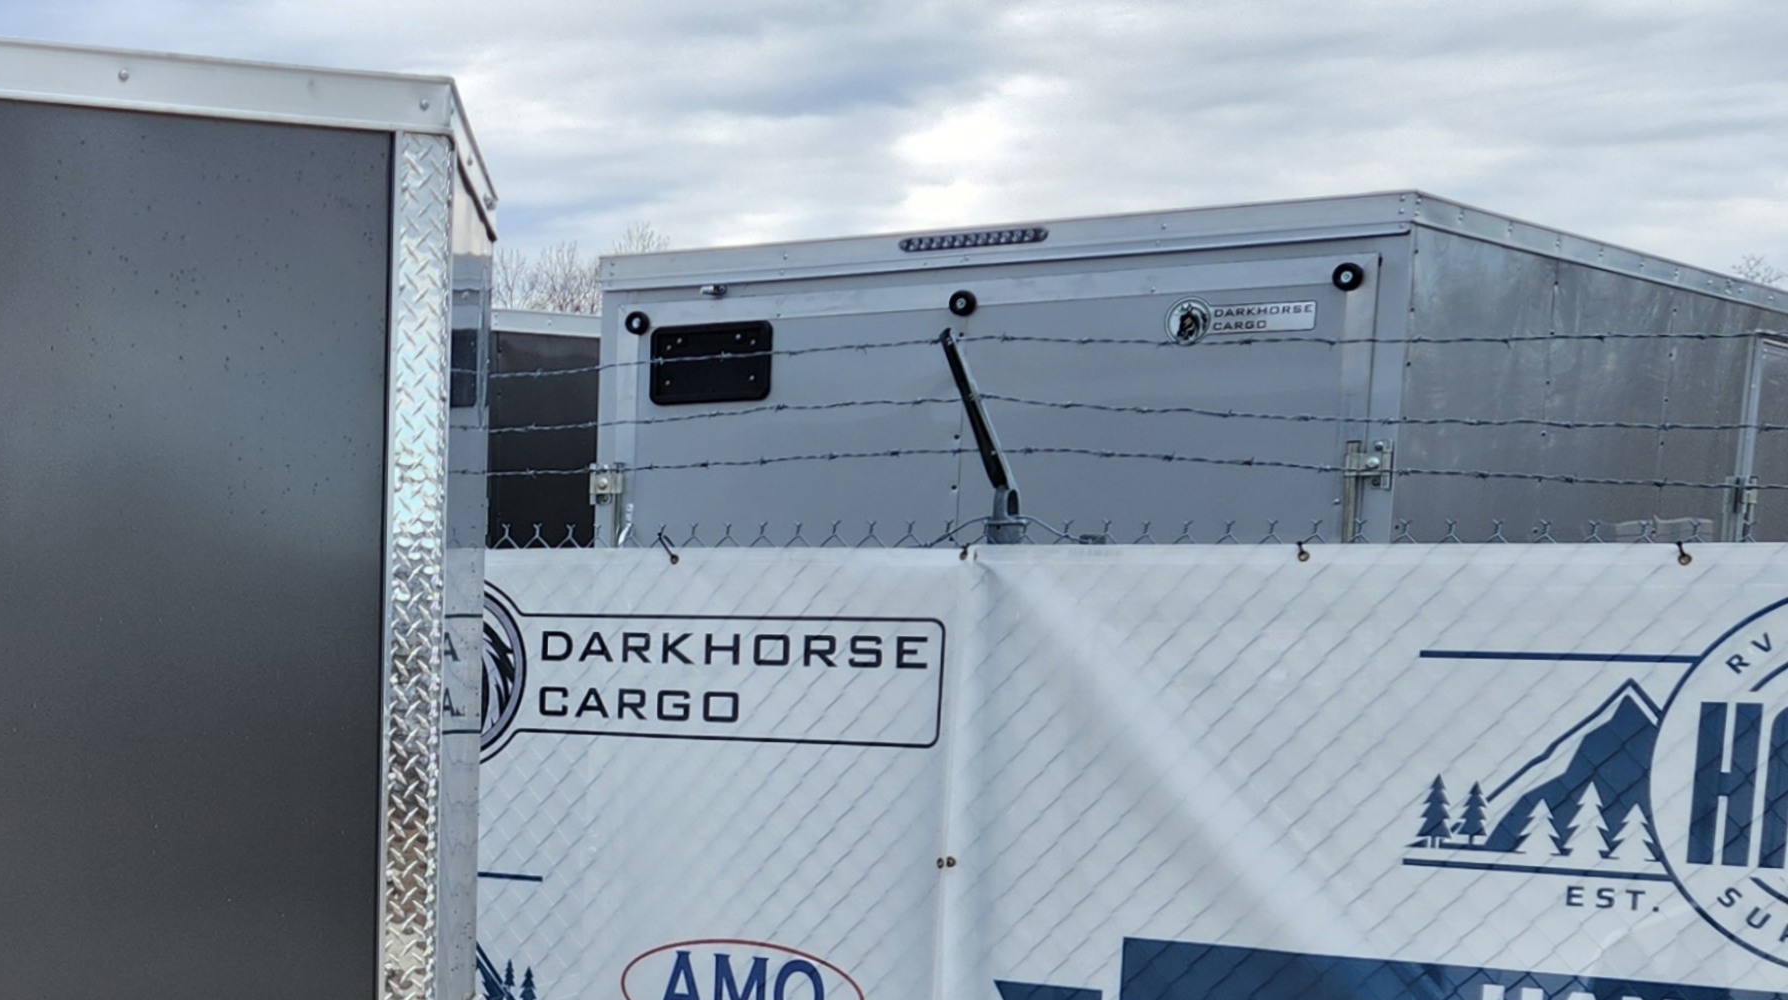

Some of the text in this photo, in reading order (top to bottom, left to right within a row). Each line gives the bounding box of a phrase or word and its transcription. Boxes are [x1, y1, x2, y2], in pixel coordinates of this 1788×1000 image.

[1214, 304, 1313, 318] DARKHORSE
[1213, 320, 1267, 331] CARGO
[540, 630, 929, 669] DARKHORSE
[538, 685, 740, 723] CARGO
[1565, 886, 1660, 912] EST.
